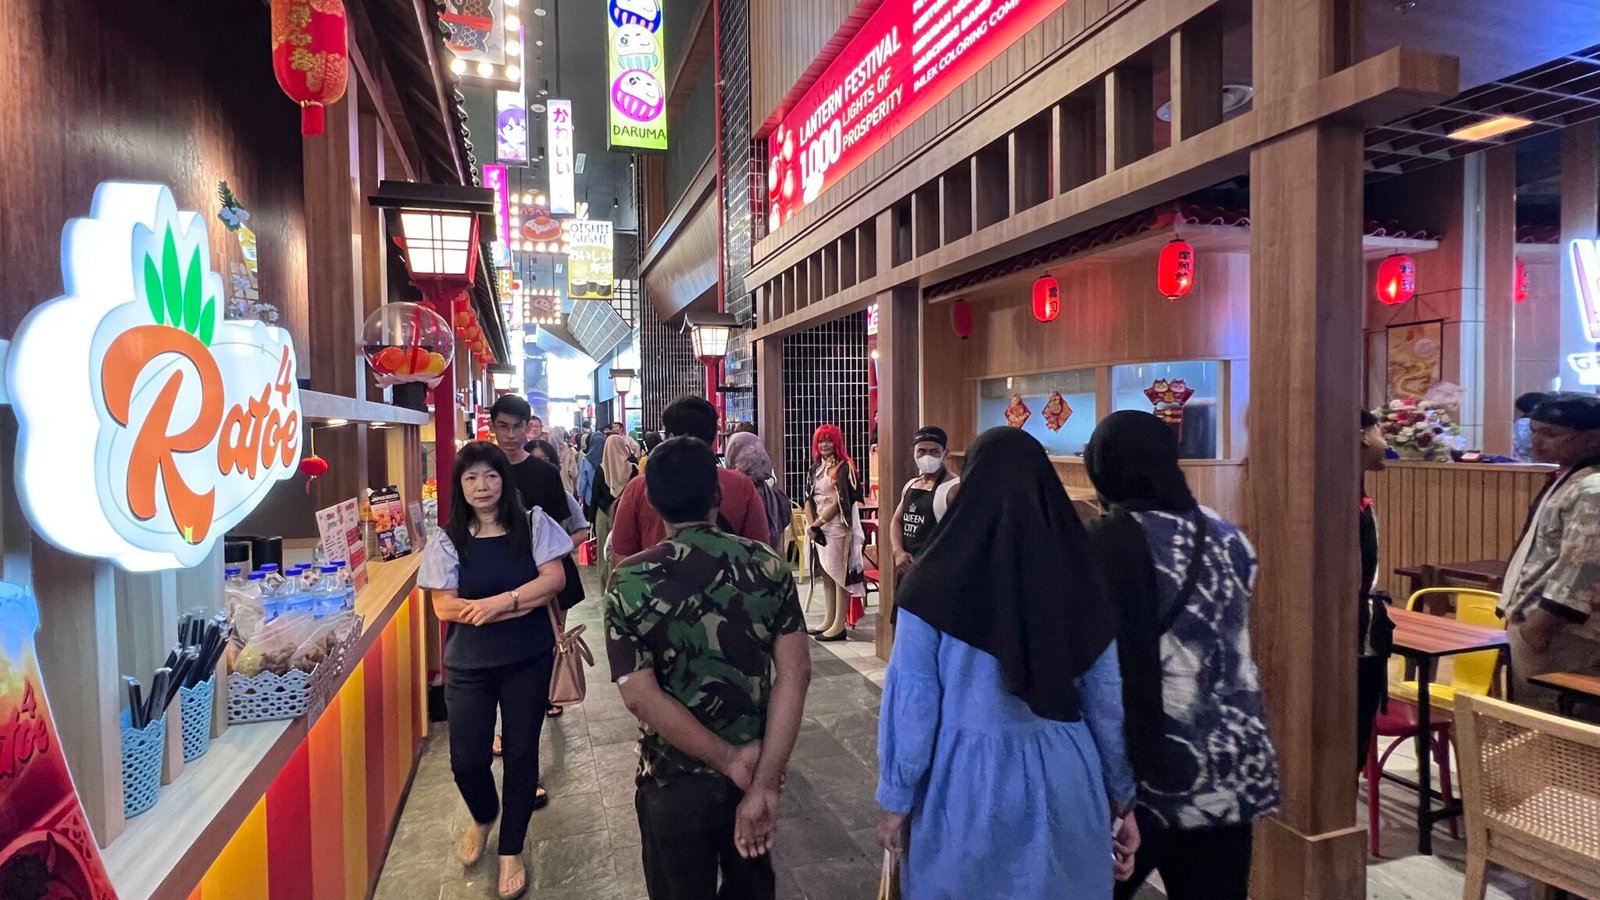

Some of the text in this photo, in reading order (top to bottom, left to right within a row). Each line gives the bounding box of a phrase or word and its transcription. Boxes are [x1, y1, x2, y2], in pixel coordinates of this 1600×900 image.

[938, 20, 988, 71] COLORING
[800, 25, 902, 147] LANTERN FESTIVAL
[842, 66, 892, 128] LIGHTS OF
[552, 107, 572, 175] かわいい
[613, 124, 667, 140] DARUMA
[842, 84, 904, 152] PROSPERITY
[570, 223, 609, 235] OISHII
[572, 233, 607, 245] SUSHI
[275, 344, 292, 407] 4
[101, 324, 299, 544] Ratoe
[903, 512, 925, 524] QUEEN
[904, 523, 918, 533] CITY
